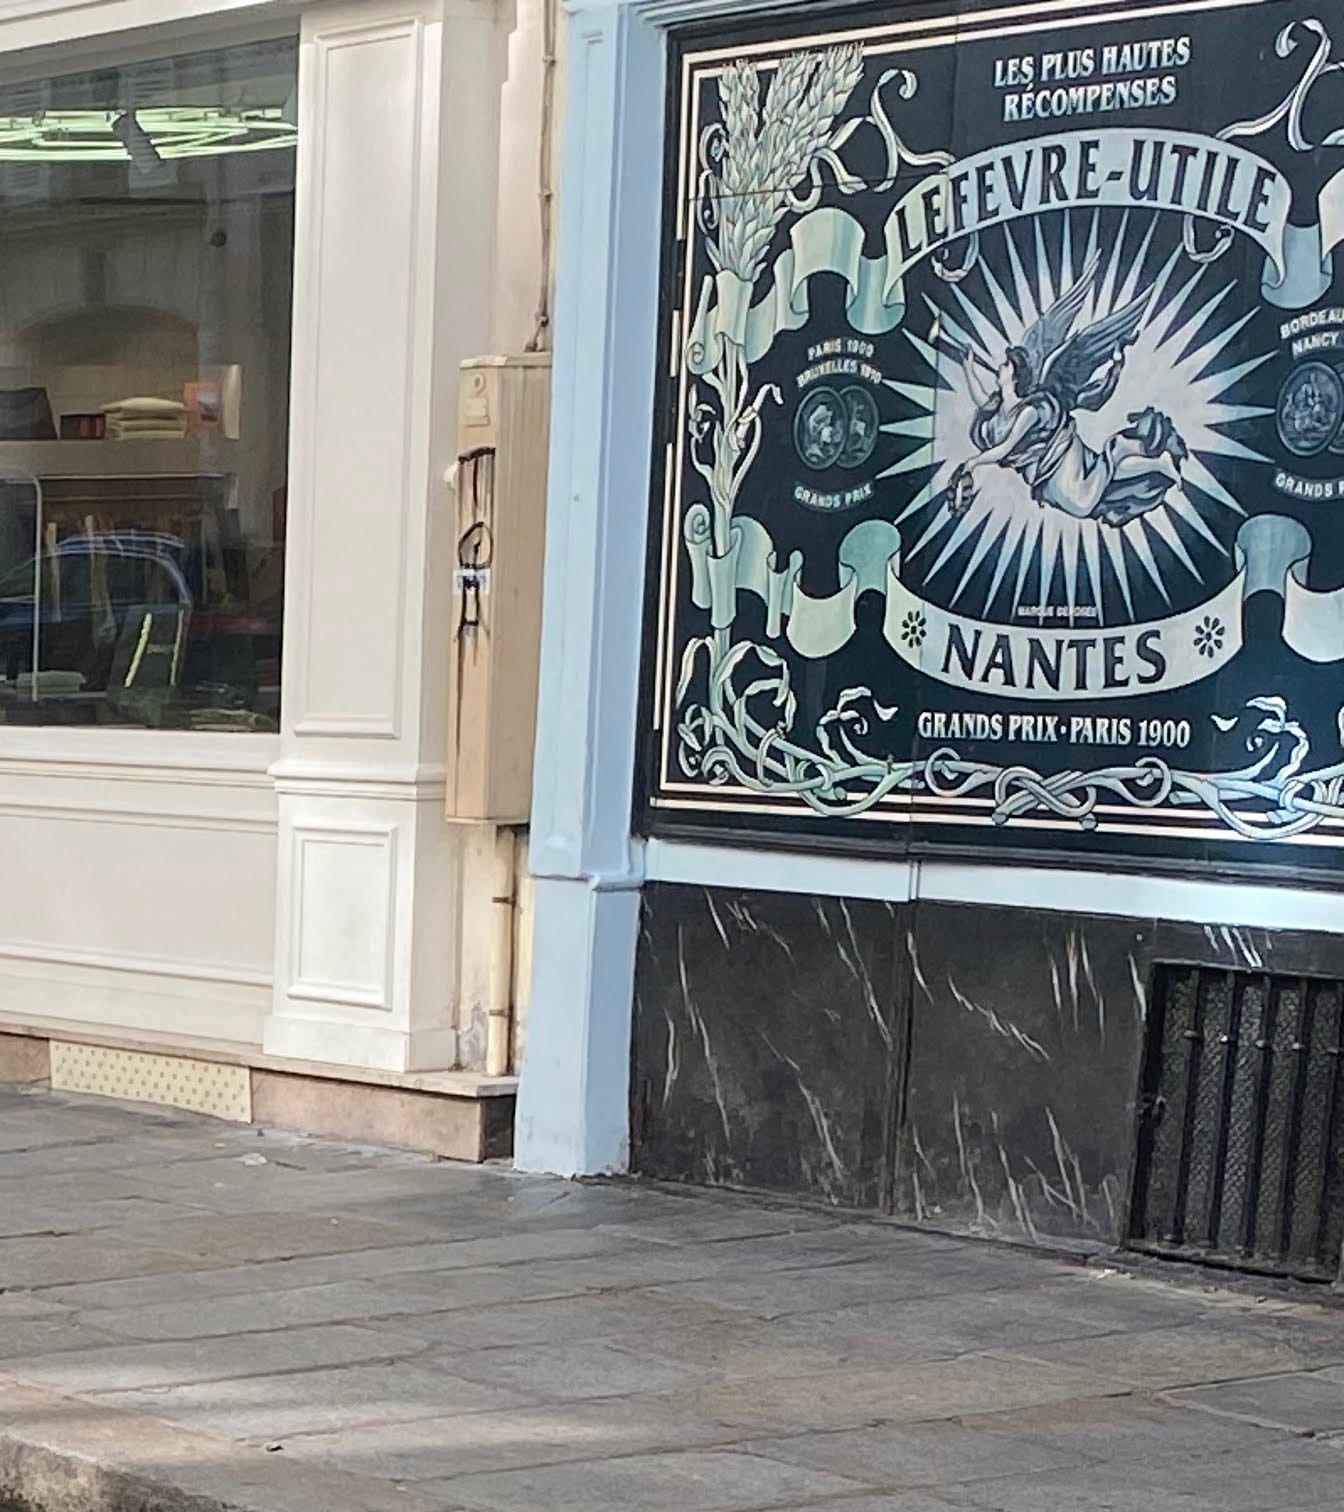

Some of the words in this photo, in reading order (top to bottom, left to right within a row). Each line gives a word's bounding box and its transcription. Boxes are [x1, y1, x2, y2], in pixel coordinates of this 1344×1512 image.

[995, 56, 1034, 87] LES
[1040, 49, 1095, 82] PLUS
[1101, 36, 1191, 76] HAUTES
[1003, 76, 1177, 122] RÉCOMPENSES
[894, 138, 1278, 264] LEFEVRE-UTILE
[808, 337, 842, 361] PARIS
[1292, 331, 1340, 360] NANCY
[794, 485, 842, 508] GRANDS
[845, 482, 872, 505] PRIX
[1275, 472, 1333, 498] GRANDS
[941, 622, 1167, 692] NANTES
[917, 711, 1003, 741] GRANDS
[1008, 714, 1059, 742] PRIX
[1069, 716, 1131, 746] PARIS
[1137, 719, 1192, 749] 1900
